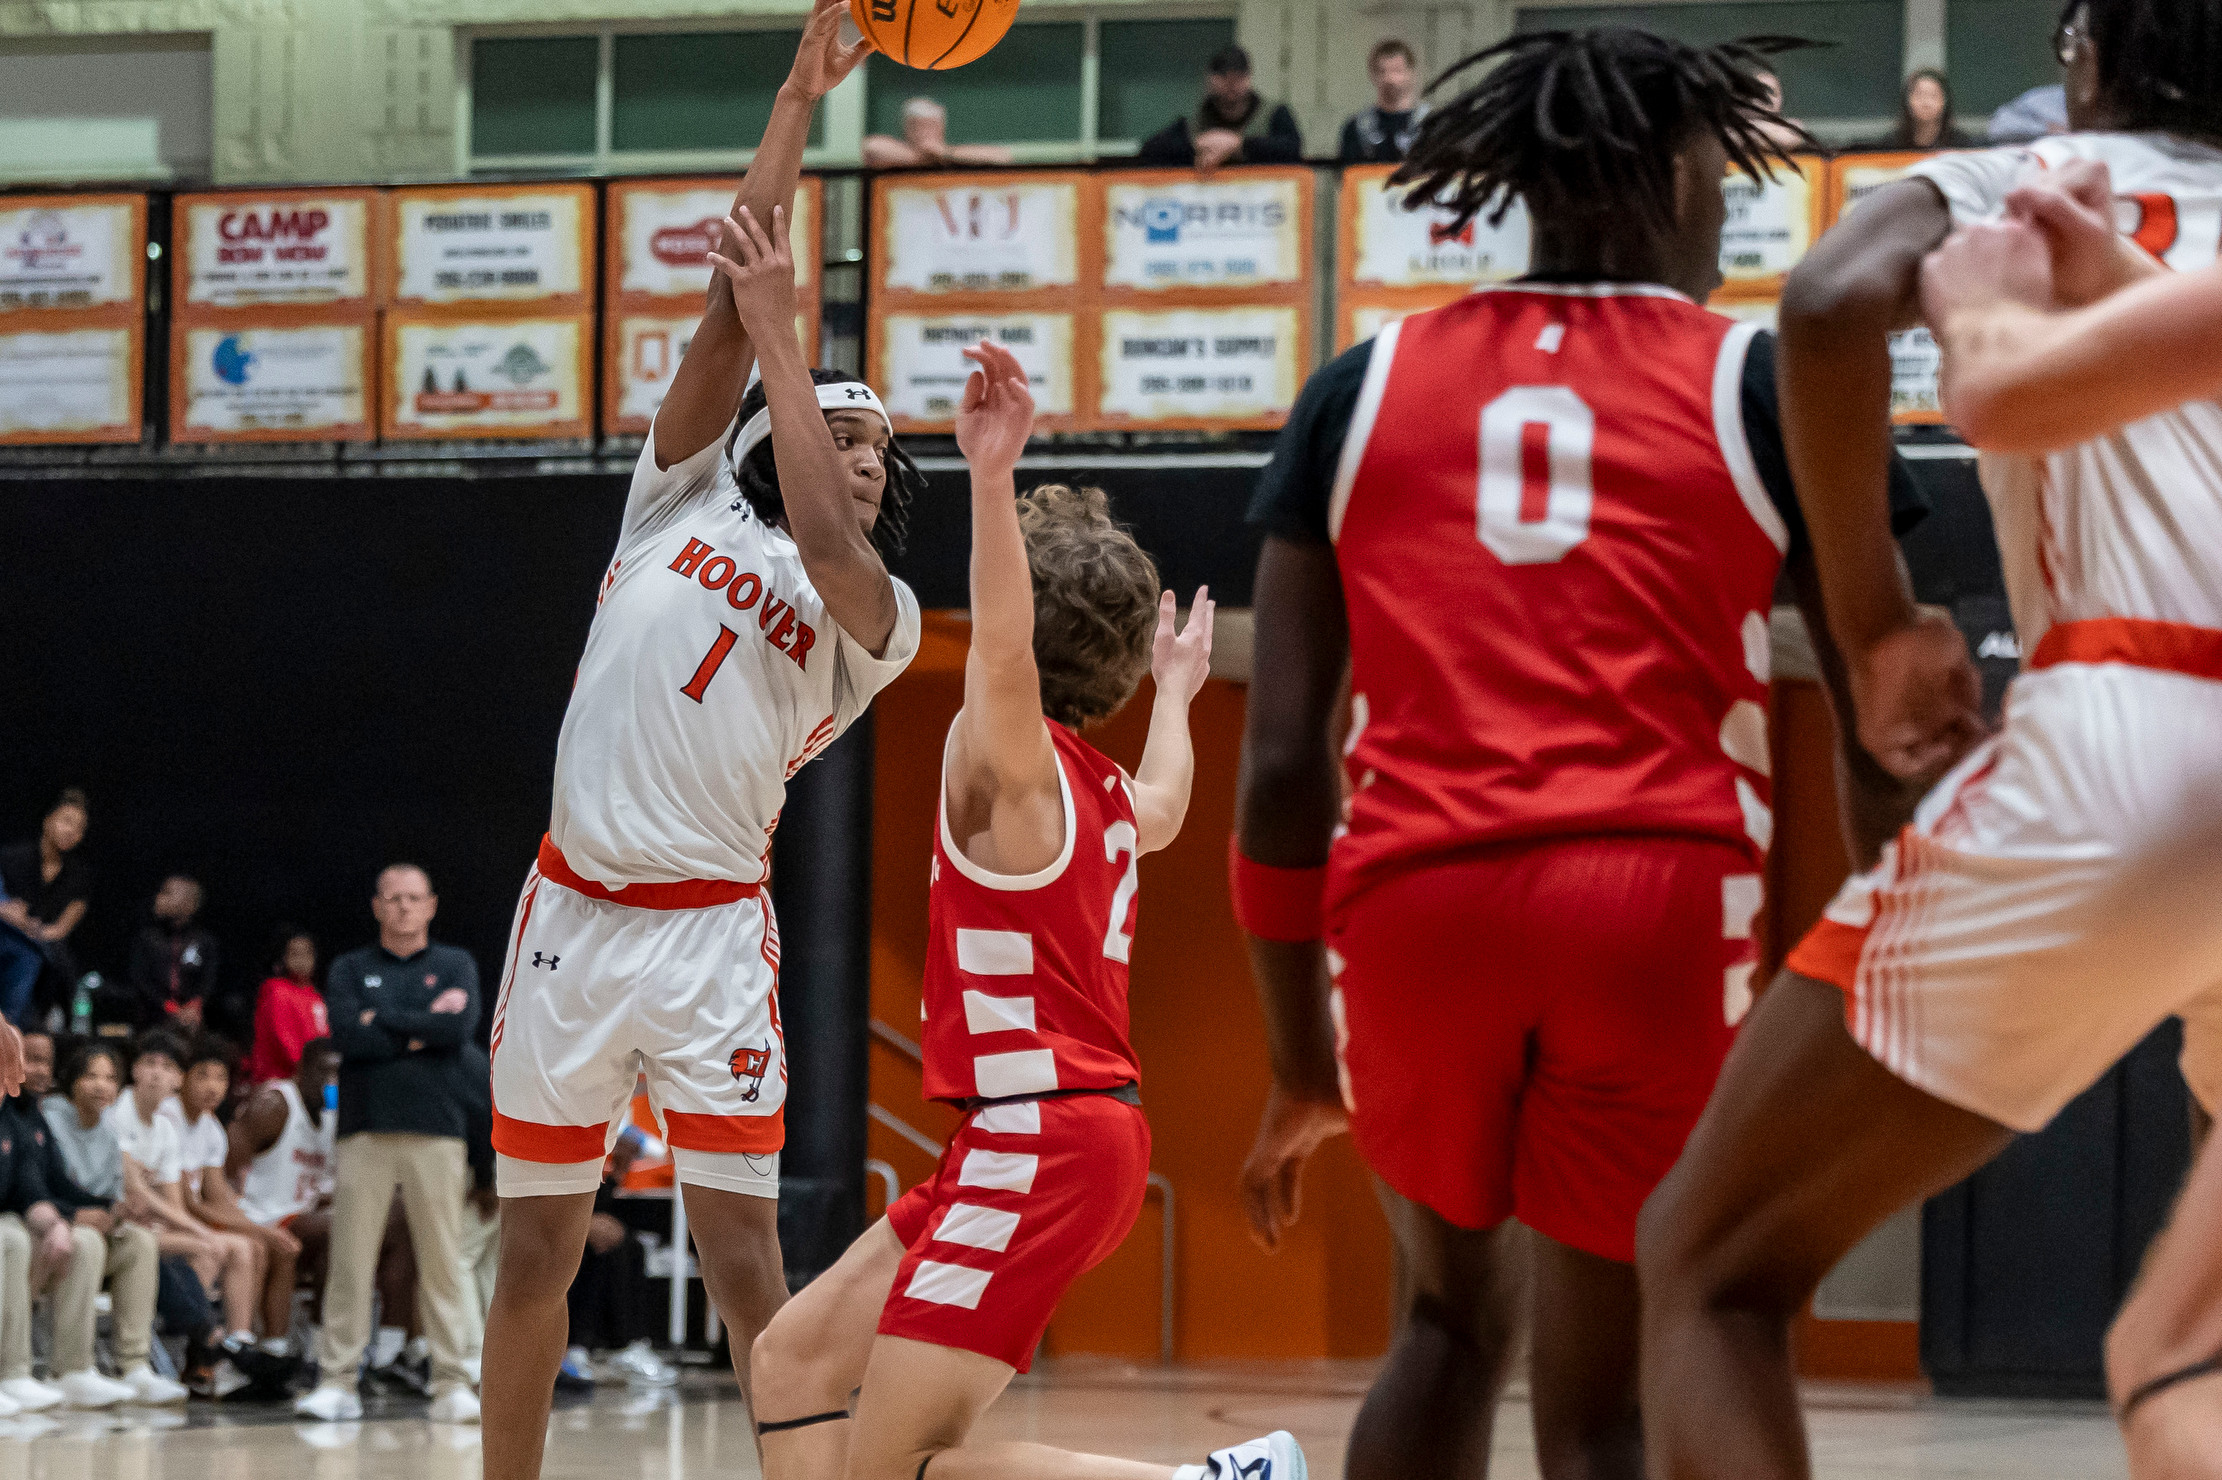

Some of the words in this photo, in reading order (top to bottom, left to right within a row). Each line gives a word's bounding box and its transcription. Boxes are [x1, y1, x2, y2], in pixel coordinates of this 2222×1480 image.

[219, 210, 328, 240] CAMP
[1476, 384, 1595, 566] 0
[667, 536, 817, 673] HOOVER
[679, 622, 739, 705] 1
[1103, 820, 1138, 965] 2
